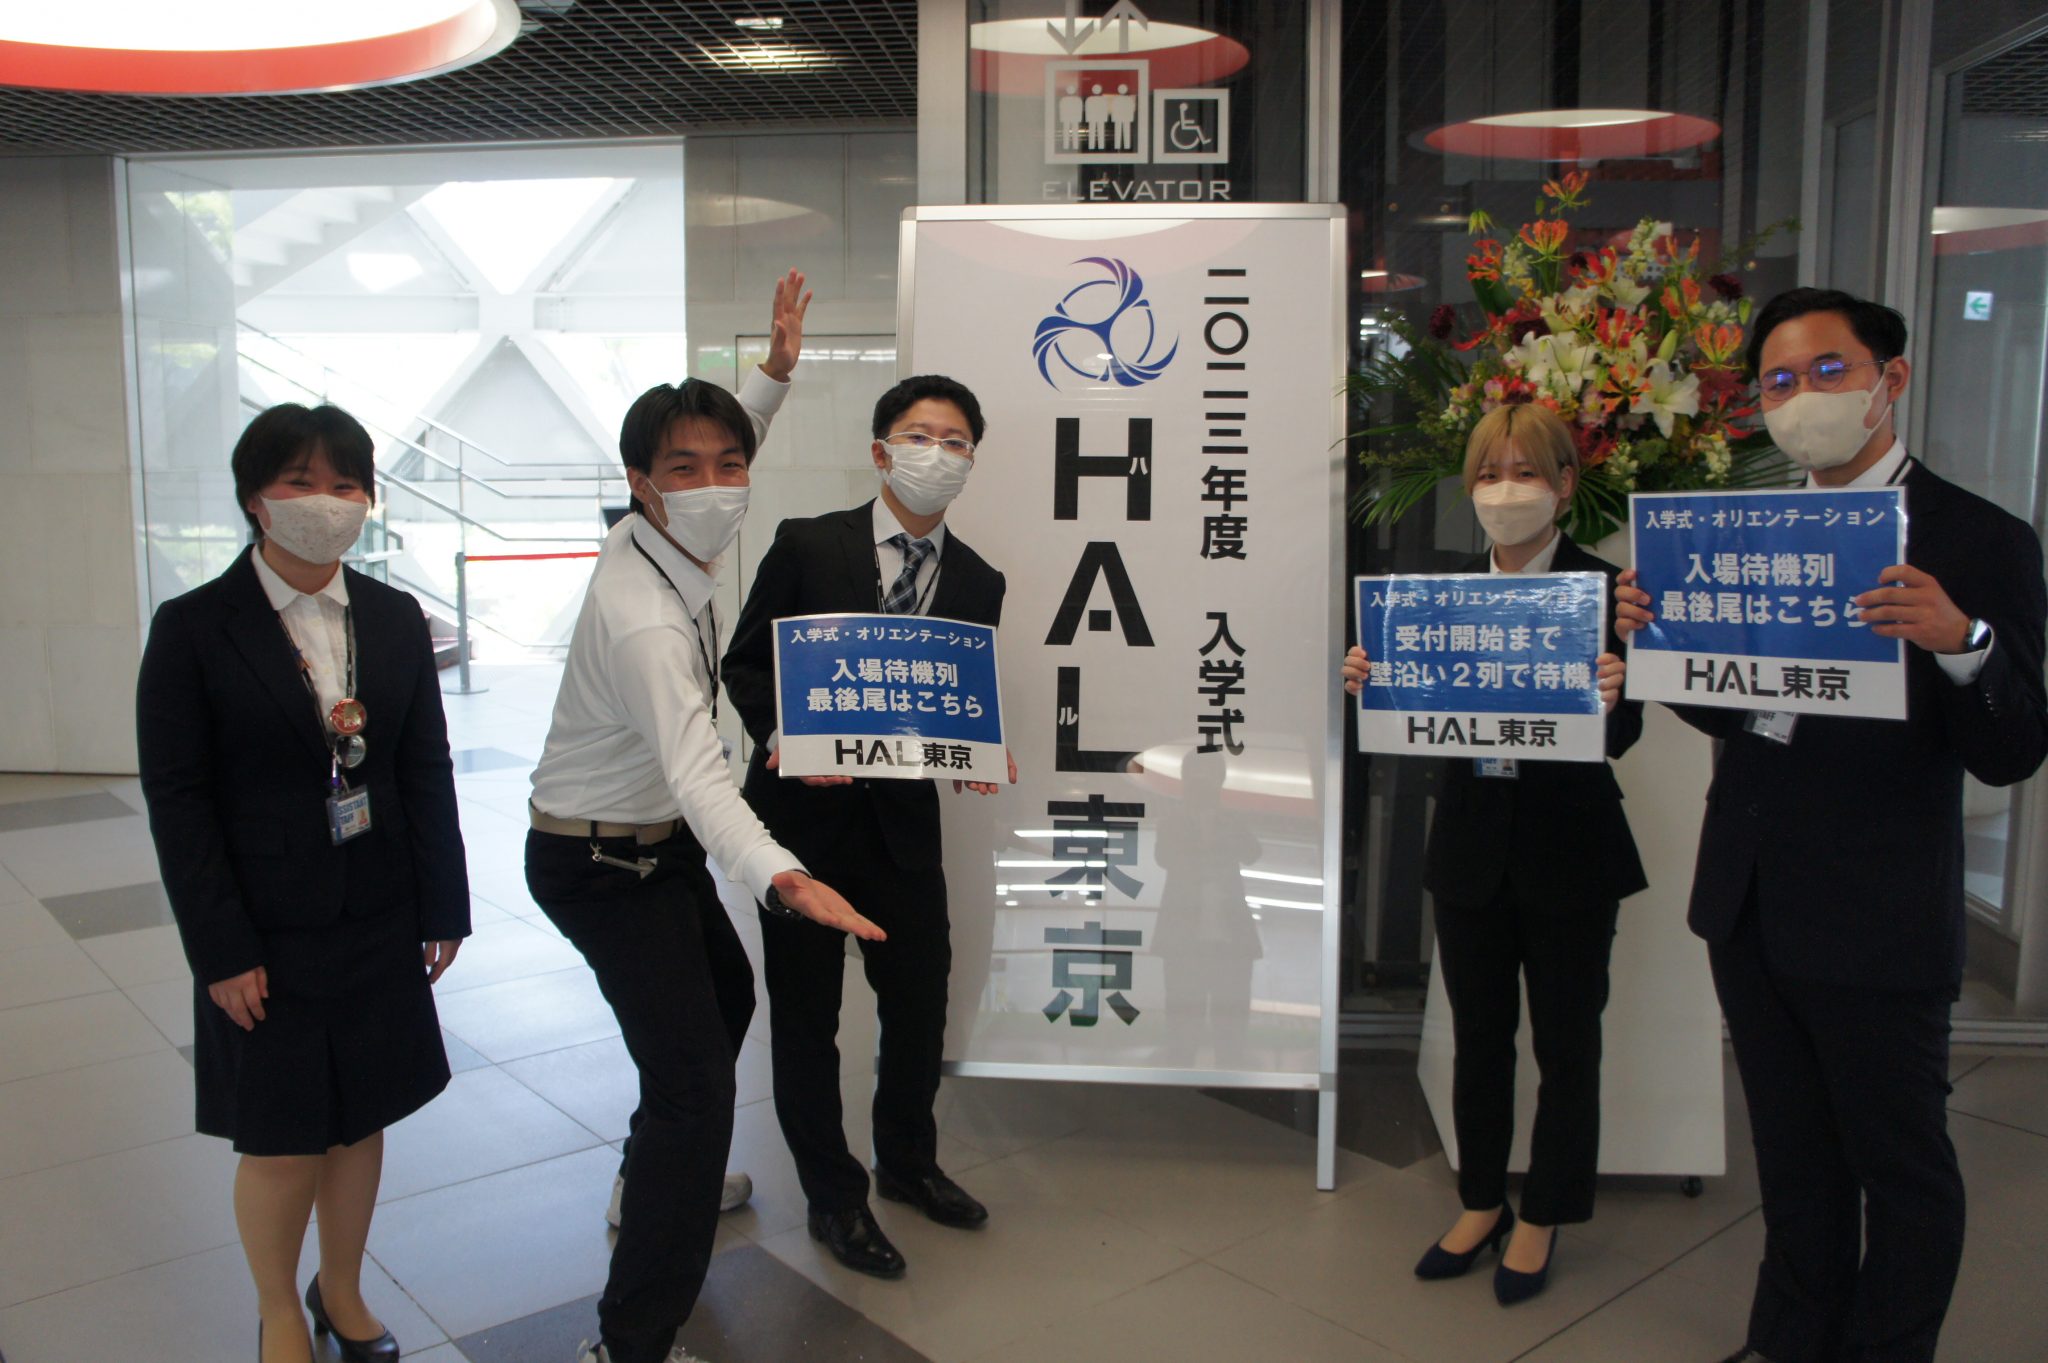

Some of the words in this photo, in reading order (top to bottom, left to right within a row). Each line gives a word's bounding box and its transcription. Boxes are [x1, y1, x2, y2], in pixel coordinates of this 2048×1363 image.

[1041, 180, 1231, 201] ELEVATOR
[1200, 268, 1250, 561] 二〇二三年度
[1645, 506, 1886, 530] 入学式・オリエンテーション
[1684, 552, 1835, 588] 入場待機列
[790, 626, 987, 650] 入学式・オリエンテーション
[1394, 624, 1563, 653] 受付開始まで
[831, 657, 959, 688] 入場待機列
[1197, 611, 1247, 757] 入学式
[1684, 658, 1851, 701] HAL東京
[806, 687, 984, 718] 最後尾はこちら
[1407, 716, 1558, 747] HAL東京
